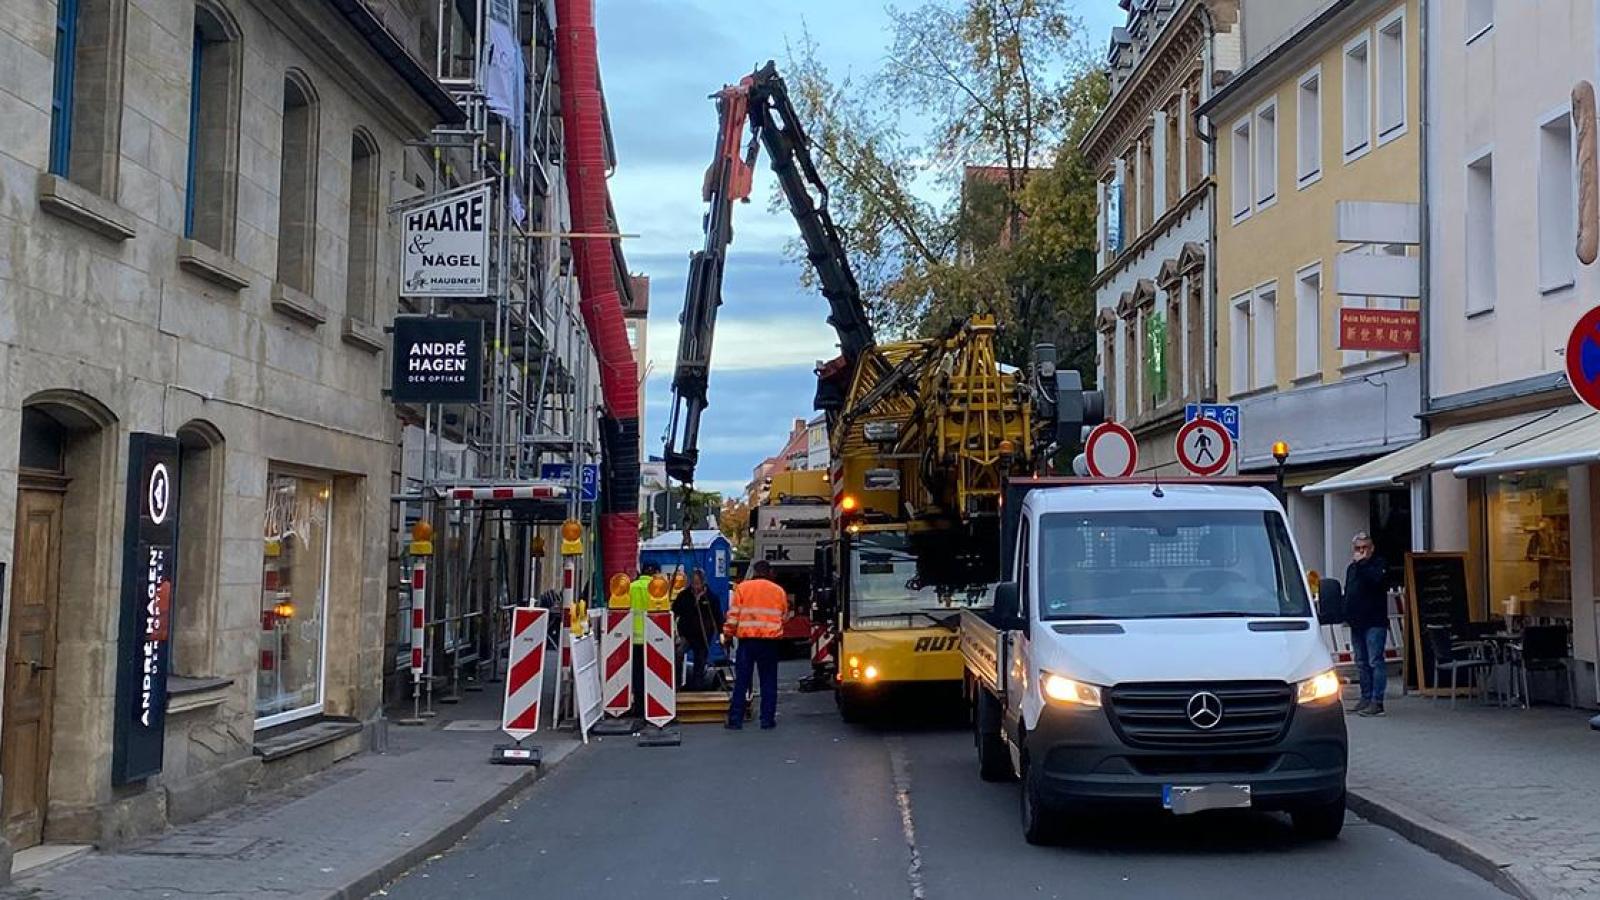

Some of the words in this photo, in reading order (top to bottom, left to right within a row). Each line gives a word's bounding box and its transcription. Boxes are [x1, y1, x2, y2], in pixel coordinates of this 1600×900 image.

[409, 196, 482, 232] HAARE
[408, 234, 434, 254] &
[422, 252, 481, 267] NÄGEL
[409, 340, 466, 355] ANDRÉ
[409, 359, 466, 371] HAGEN
[141, 642, 153, 727] ANDRÉ
[147, 547, 157, 634] HAGEN
[914, 636, 960, 652] AUT
[151, 640, 159, 674] DER
